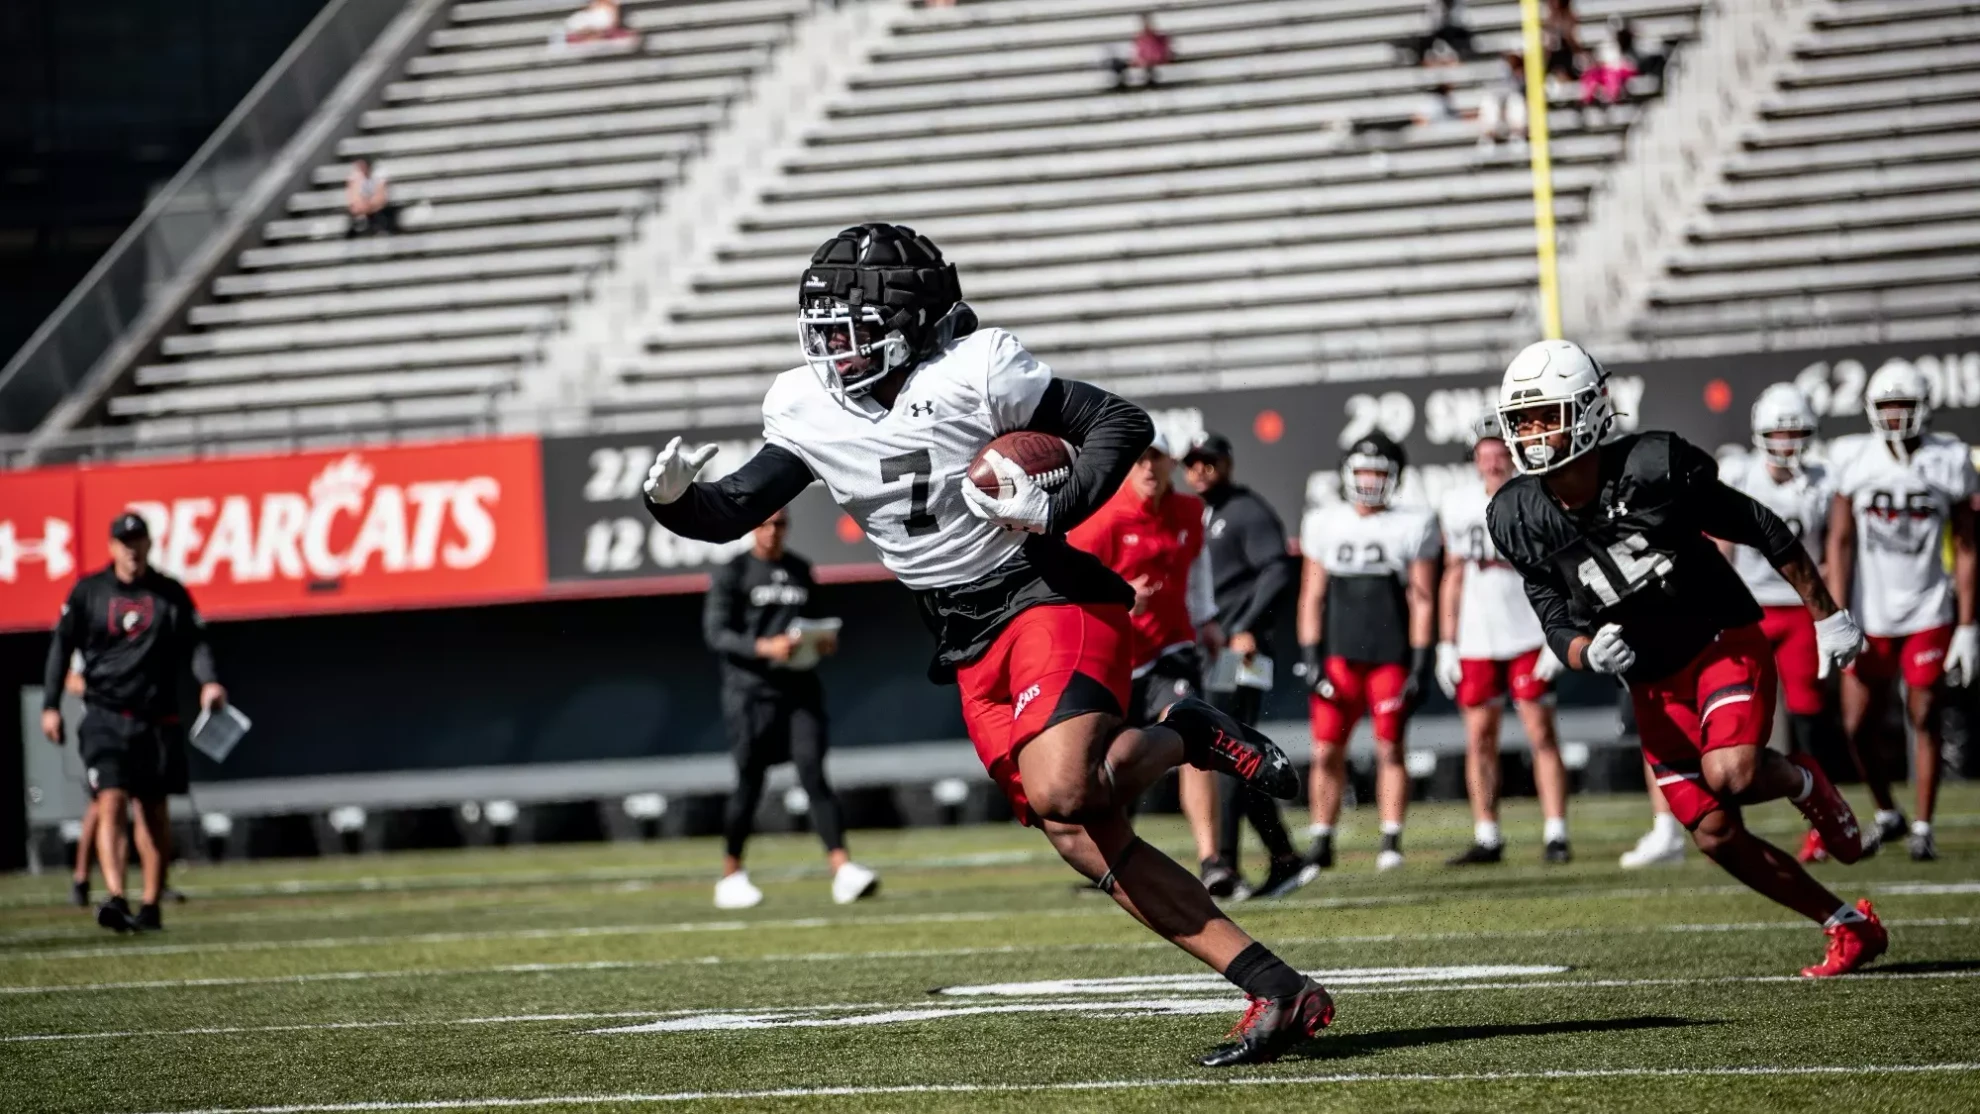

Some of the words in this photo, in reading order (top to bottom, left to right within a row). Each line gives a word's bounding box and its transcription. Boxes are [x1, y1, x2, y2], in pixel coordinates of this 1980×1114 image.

[584, 446, 654, 501] 27
[880, 448, 940, 537] 7
[125, 454, 500, 584] BEARCATS
[584, 516, 645, 573] 12
